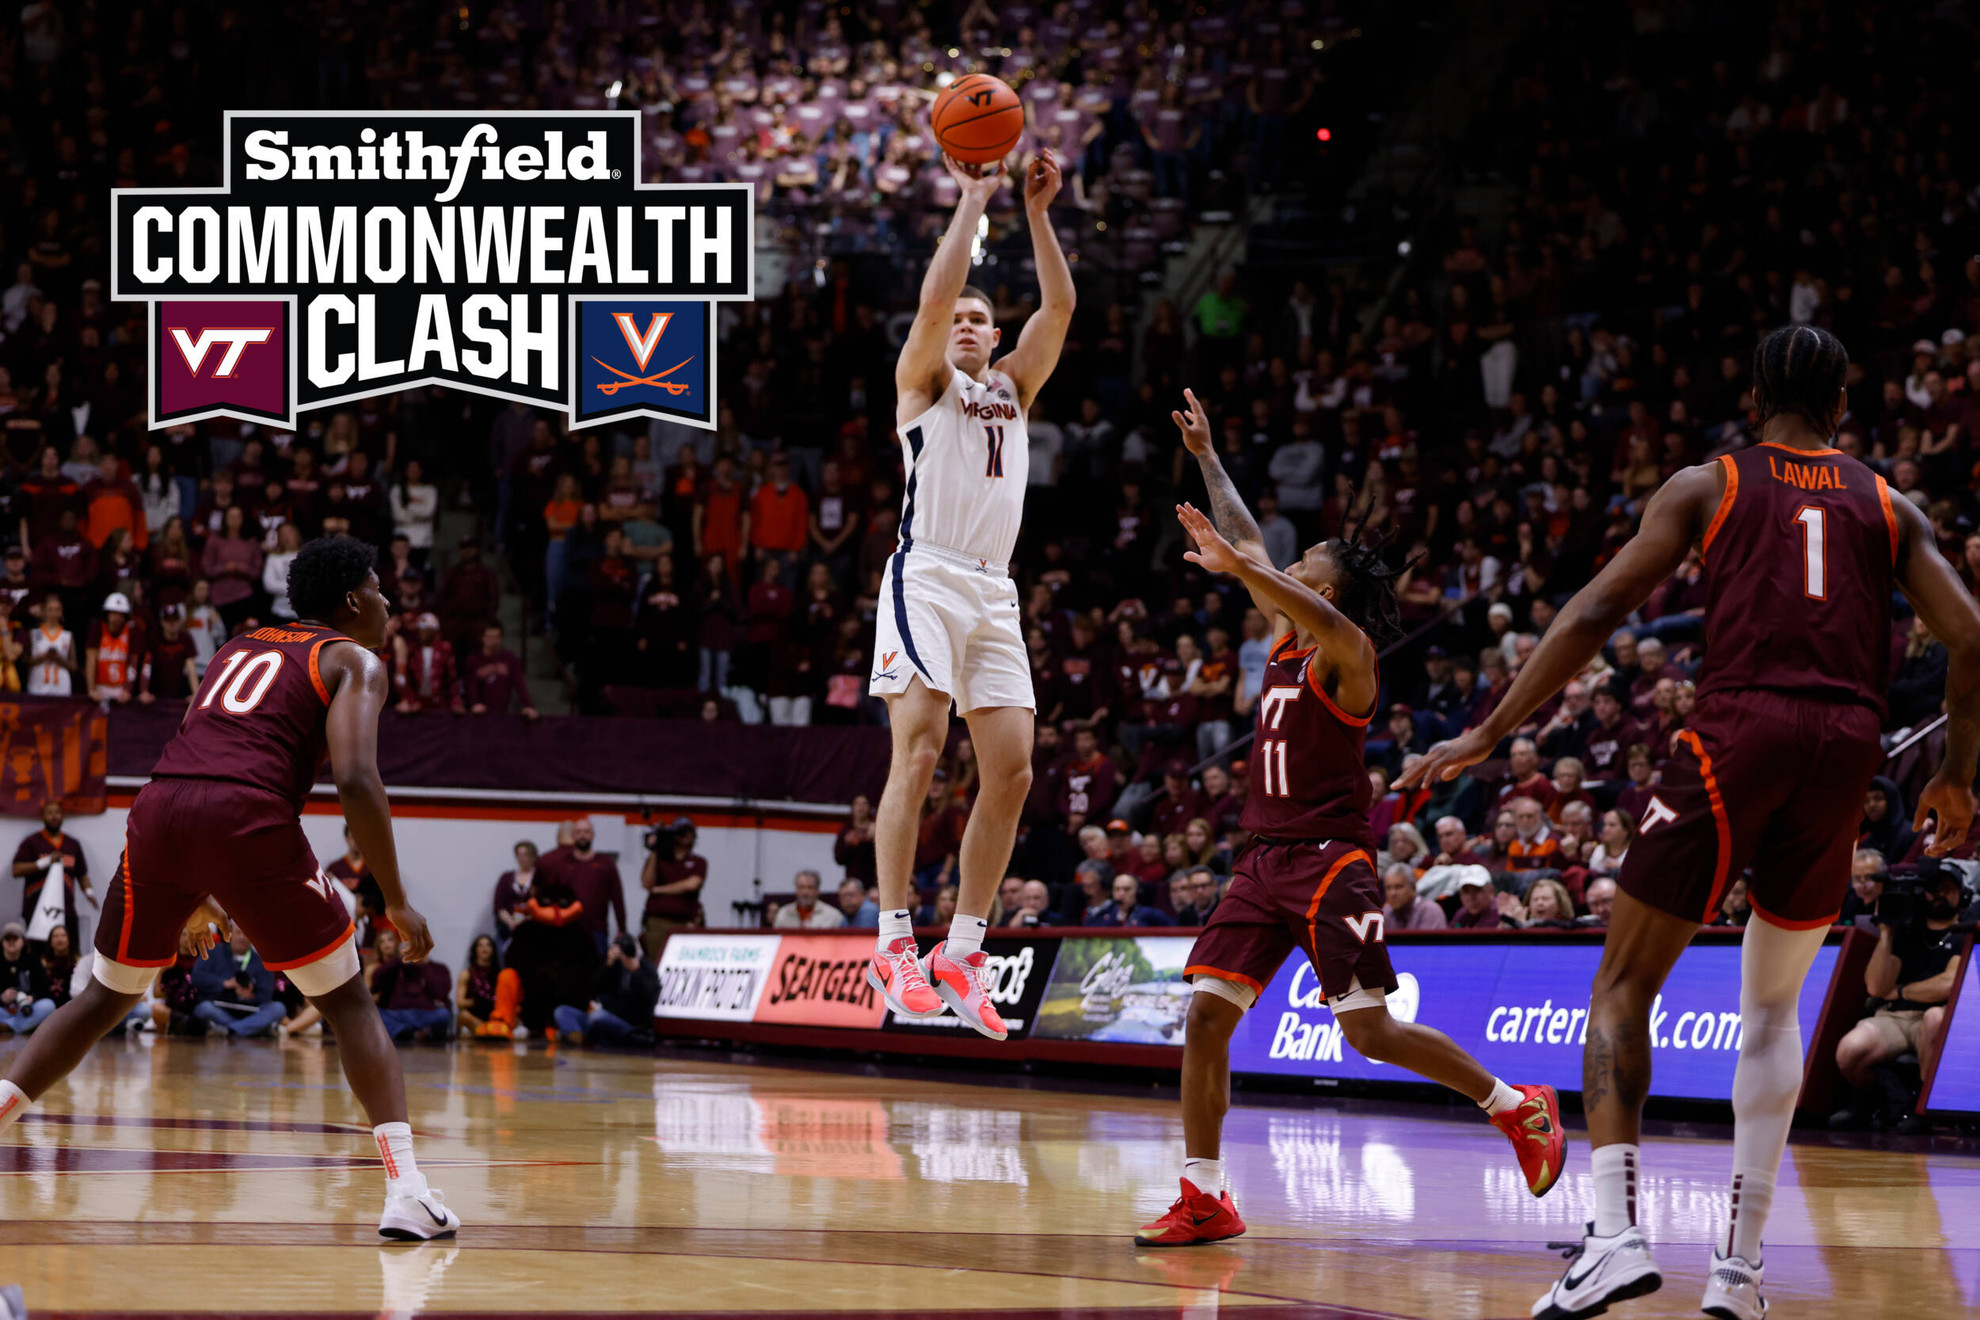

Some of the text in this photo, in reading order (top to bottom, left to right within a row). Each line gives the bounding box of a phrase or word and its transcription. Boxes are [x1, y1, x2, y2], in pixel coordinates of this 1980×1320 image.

[965, 89, 997, 107] VT
[984, 425, 1004, 478] 11
[1768, 456, 1848, 490] LAWAL
[1792, 505, 1828, 602] 1
[245, 626, 318, 643] JOHNSON
[198, 649, 285, 715] 10
[882, 651, 898, 672] V
[1261, 739, 1291, 798] 11
[1341, 911, 1385, 944] VT
[769, 953, 875, 1010] SEATGEEK
[1268, 1011, 1344, 1063] Bank
